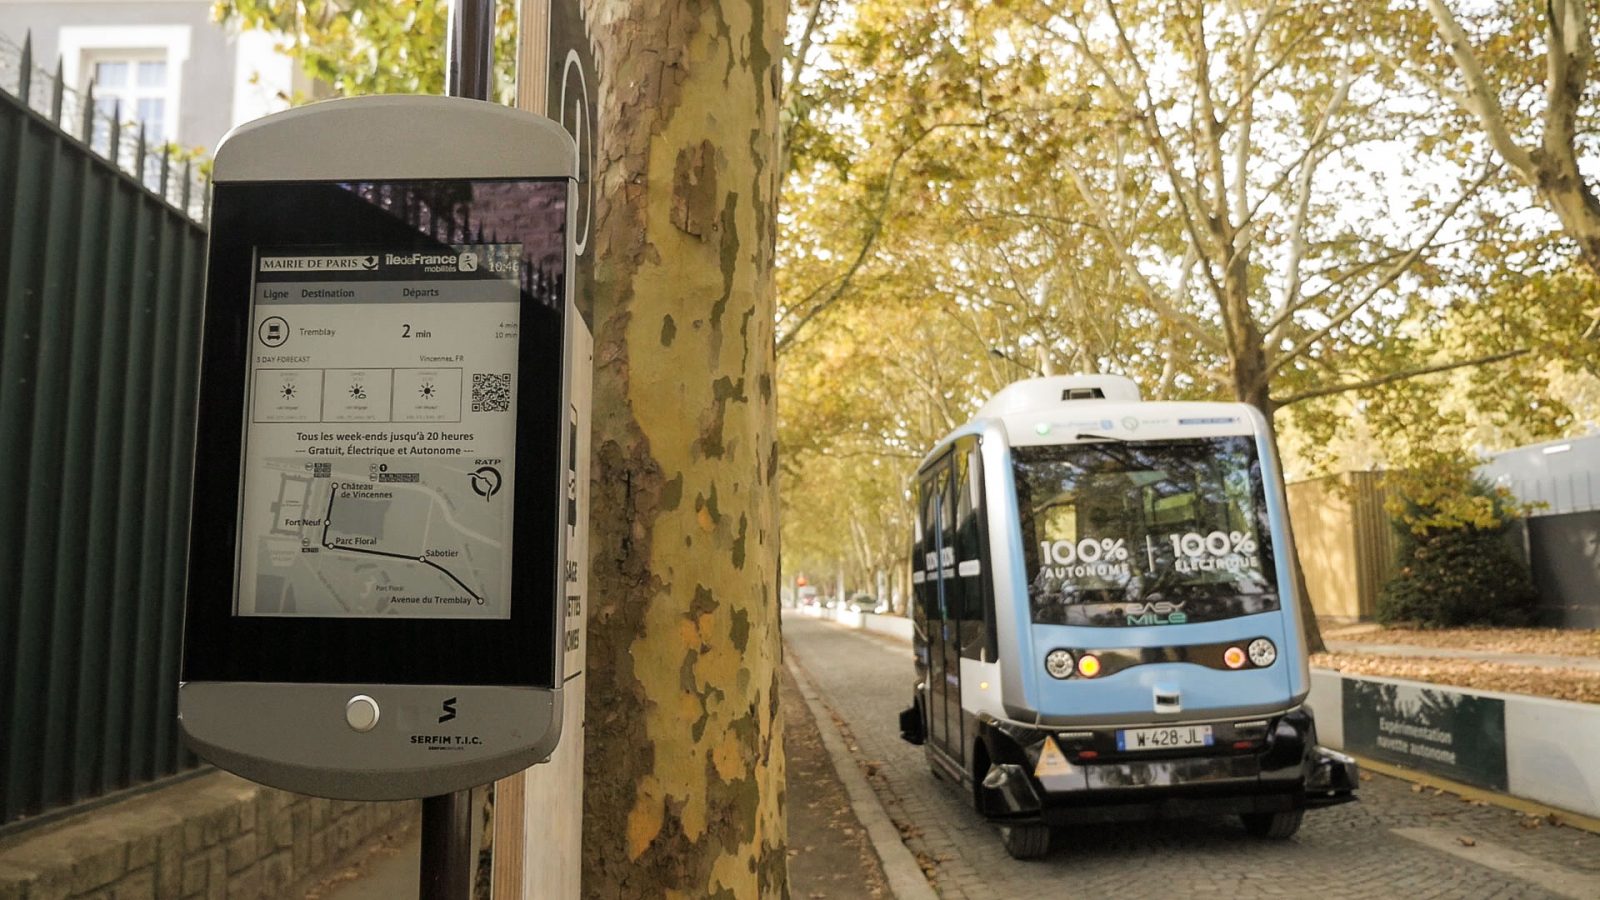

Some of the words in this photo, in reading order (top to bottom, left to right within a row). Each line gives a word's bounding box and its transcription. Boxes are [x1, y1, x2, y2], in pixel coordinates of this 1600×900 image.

[263, 259, 303, 269] MAIRIE
[307, 259, 323, 268] DE
[326, 258, 358, 268] PARIS
[424, 264, 457, 273] mobilités
[263, 288, 289, 301] Ligne
[301, 287, 355, 298] Destination
[402, 287, 439, 299] Départs
[299, 327, 336, 337] Tremblay
[401, 323, 411, 338] 2
[415, 329, 431, 338] min
[296, 431, 319, 441] Tous
[320, 431, 334, 441] les
[336, 431, 388, 441] week-ends
[426, 431, 439, 441] 20
[441, 431, 474, 441] heures
[308, 445, 345, 456] Gratuit,
[347, 444, 395, 457] Électrique
[397, 446, 407, 455] et
[409, 446, 461, 455] Autonome
[341, 481, 374, 491] Château
[341, 490, 351, 499] de
[353, 491, 393, 499] Vincennes
[285, 518, 301, 526] Fort
[302, 518, 321, 526] Neuf
[335, 537, 353, 545] Parc
[355, 537, 377, 545] Floral
[1040, 537, 1129, 565] 100%
[1169, 530, 1257, 558] 100%
[426, 549, 459, 557] Sabotier
[1044, 563, 1130, 579] AUTONOME
[391, 596, 422, 604] Avenue
[423, 596, 432, 604] du
[434, 596, 472, 605] Tremblay
[410, 735, 451, 744] SERFIM
[455, 736, 482, 745] T.I.C.
